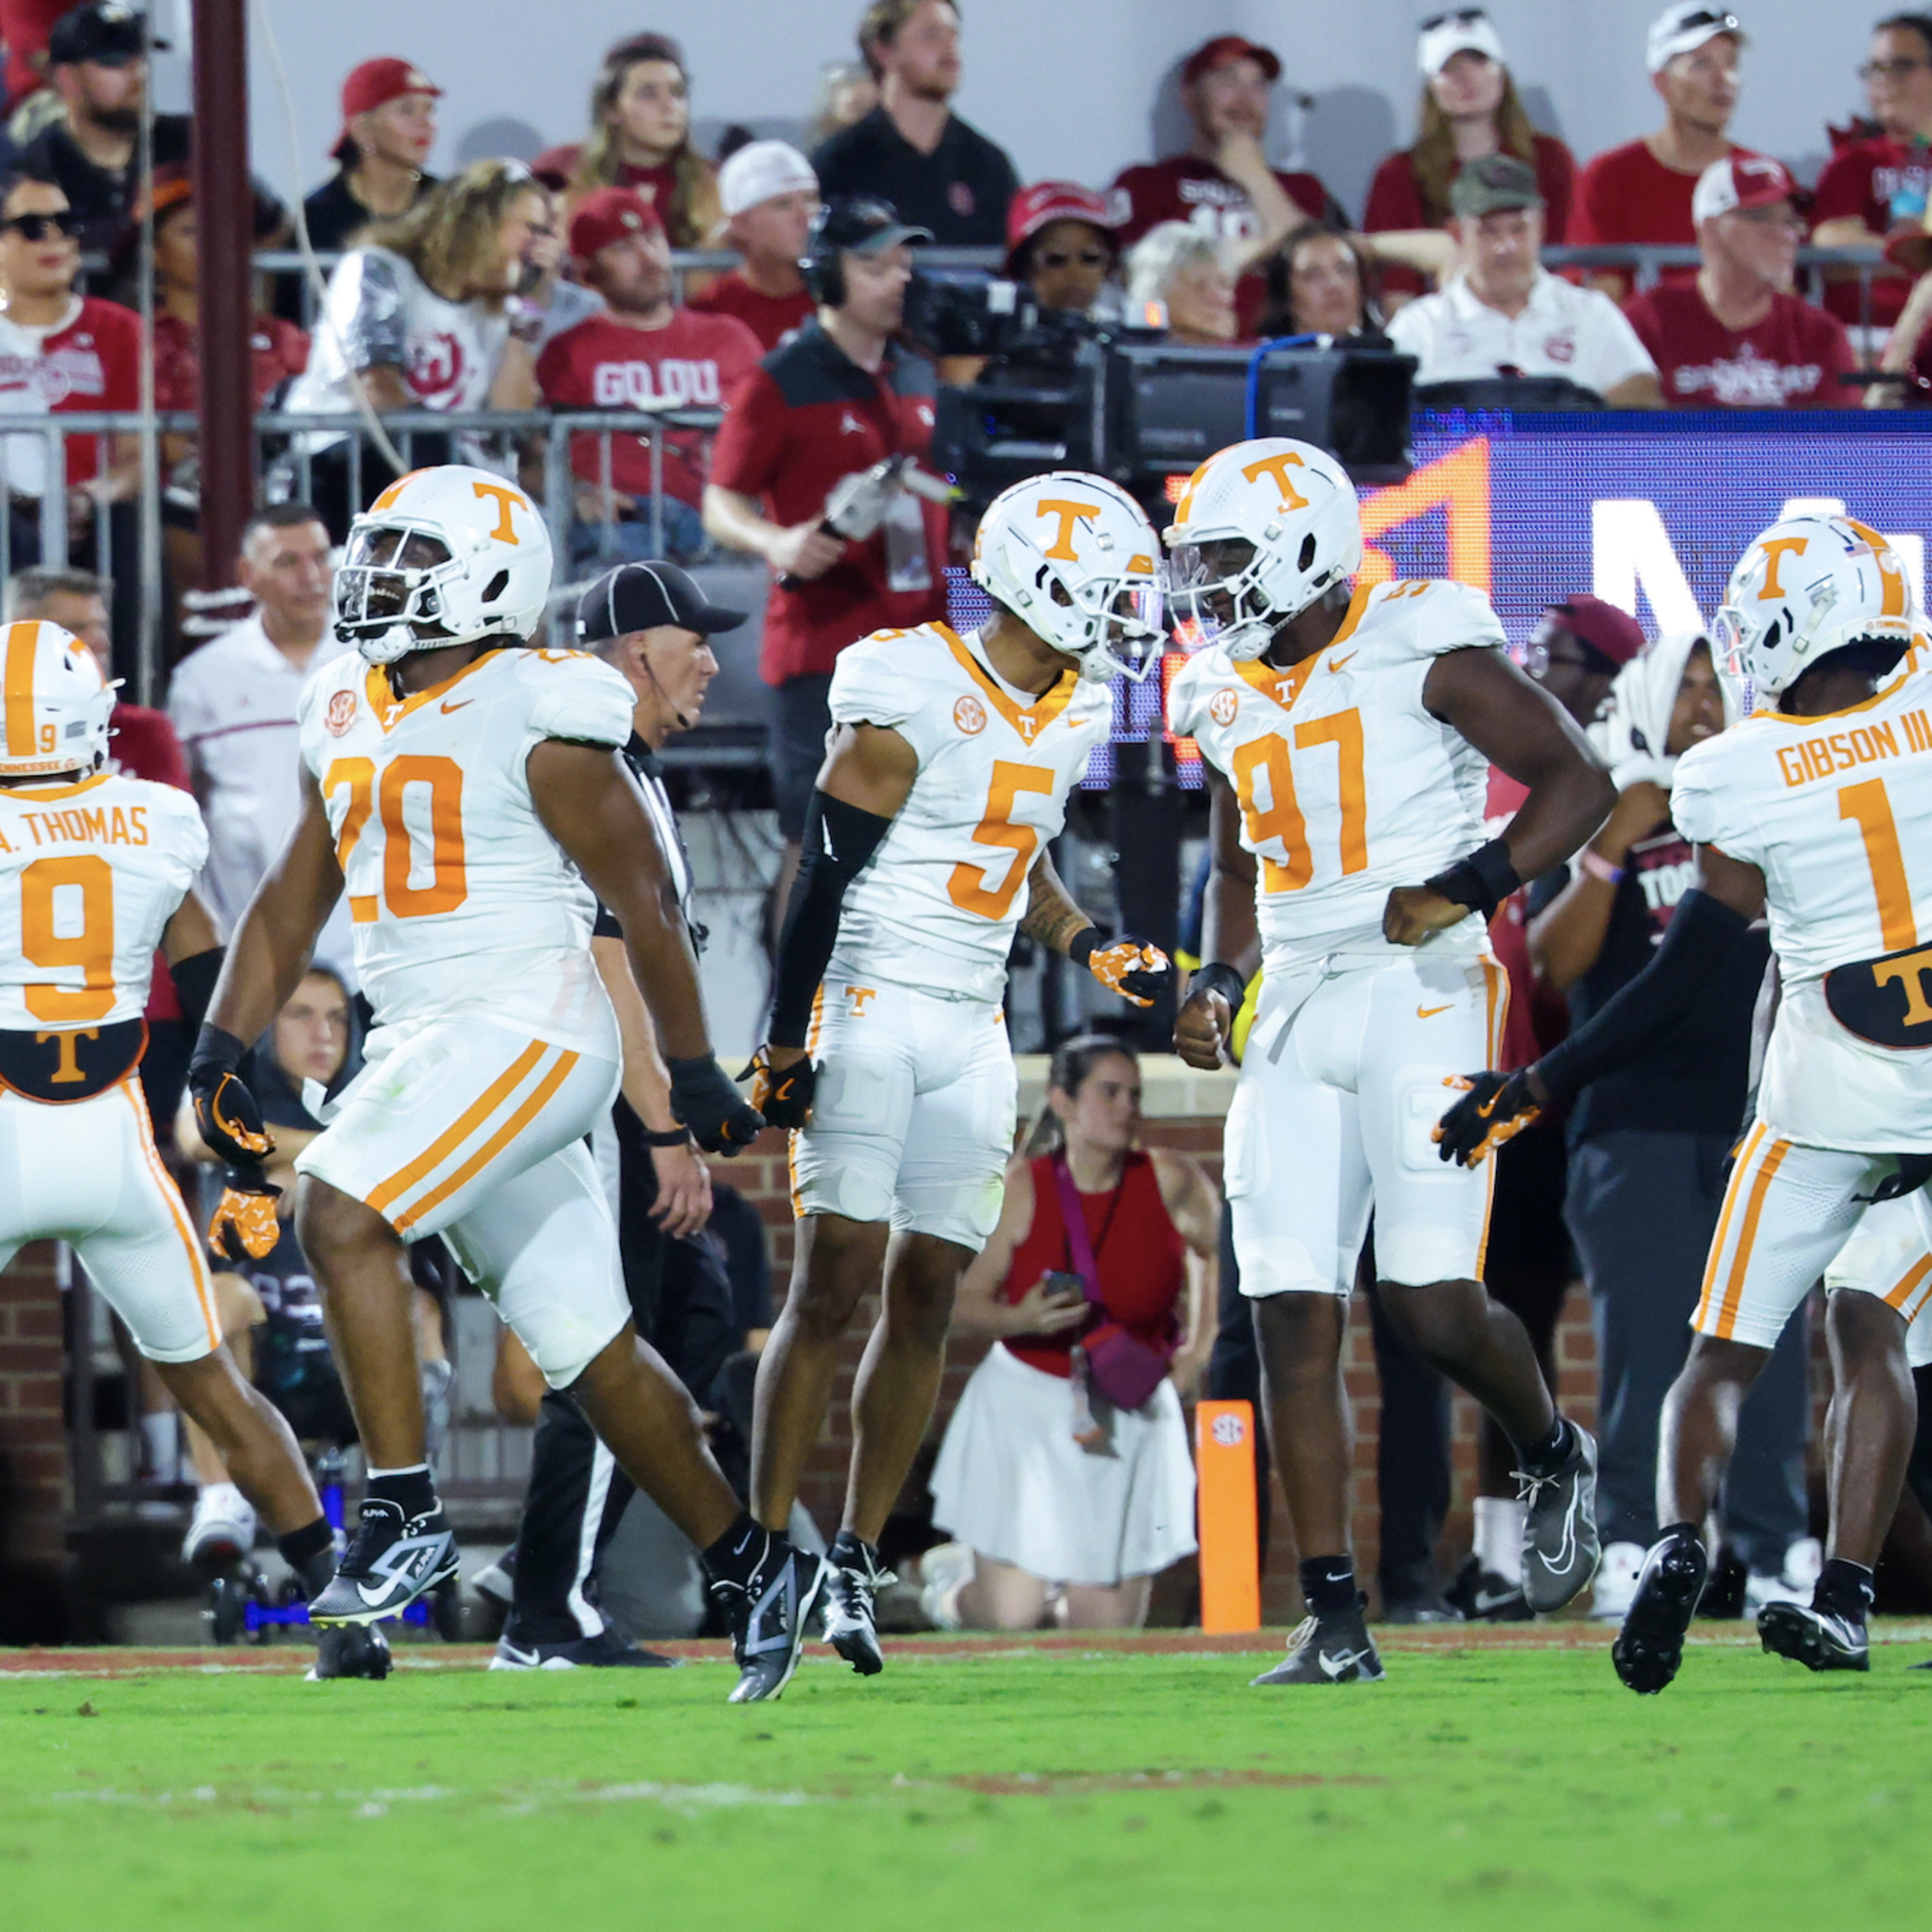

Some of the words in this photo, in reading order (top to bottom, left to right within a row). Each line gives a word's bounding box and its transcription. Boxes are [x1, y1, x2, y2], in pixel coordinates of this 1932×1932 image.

[660, 359, 719, 406] OU
[472, 482, 527, 545] T
[1242, 452, 1309, 514] T
[1037, 499, 1101, 562] T
[1757, 537, 1809, 600] T
[384, 704, 405, 726] T
[956, 698, 985, 732] SEC
[1211, 690, 1237, 723] SEC
[1275, 679, 1296, 703] T
[41, 724, 55, 753] 9
[1018, 715, 1035, 738] T
[1776, 720, 1900, 787] GIBSON
[20, 806, 148, 846] THOMAS
[1233, 707, 1368, 894] 97
[324, 755, 468, 922] 20
[946, 760, 1056, 921] 5
[1838, 777, 1917, 951] 1
[21, 854, 117, 1022] 9
[846, 987, 876, 1017] T
[1872, 948, 1932, 1026] T
[36, 1030, 99, 1083] T
